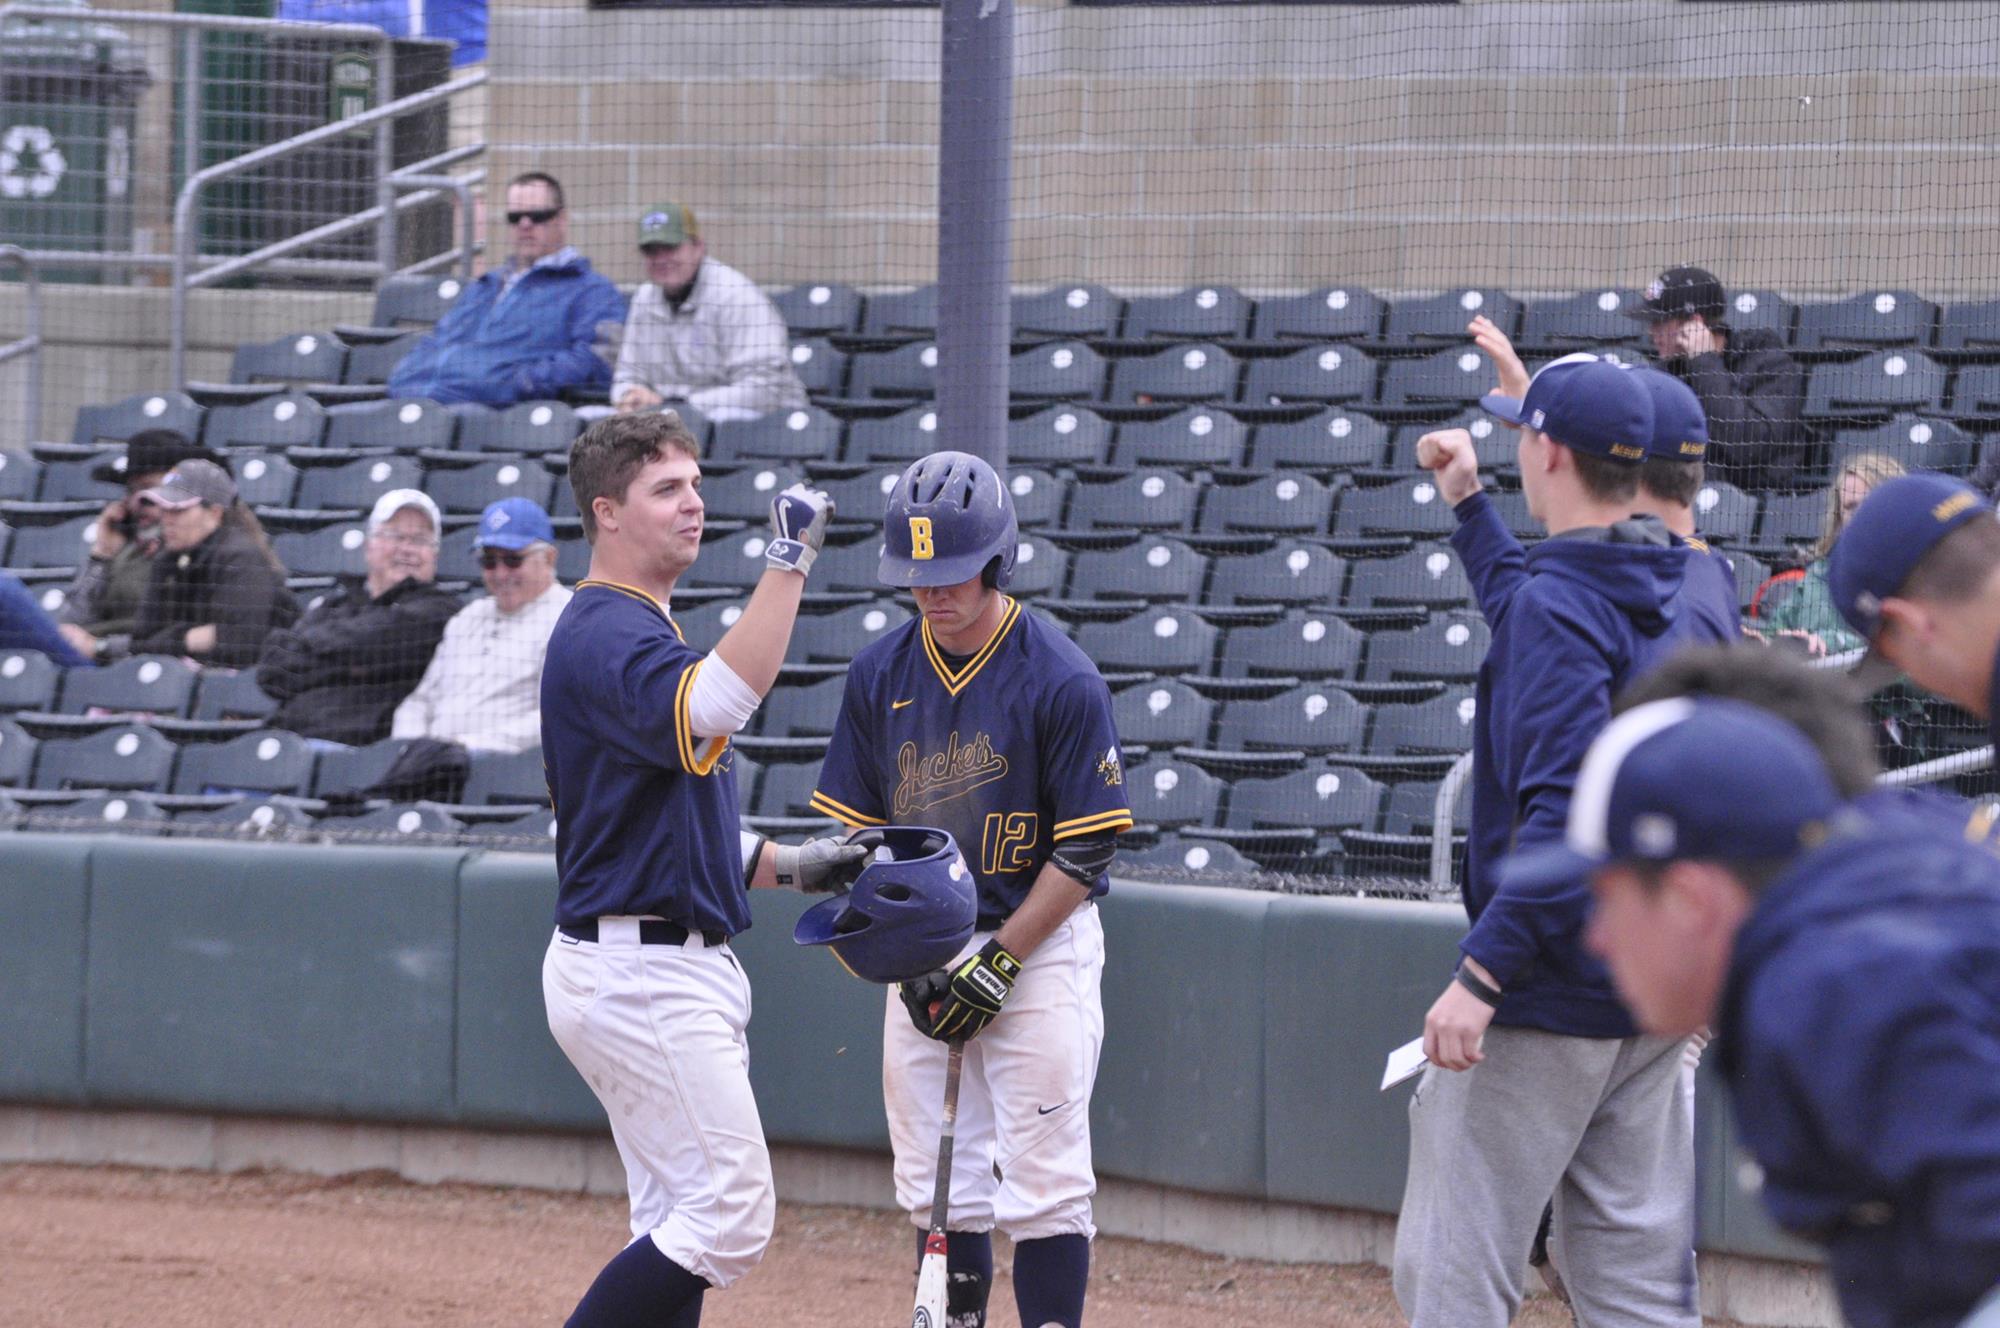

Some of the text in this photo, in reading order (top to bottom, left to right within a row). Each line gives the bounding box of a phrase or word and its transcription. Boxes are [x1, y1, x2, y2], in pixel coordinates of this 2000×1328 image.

[909, 516, 935, 560] B
[895, 728, 1008, 816] Jackets
[982, 811, 1038, 875] 12
